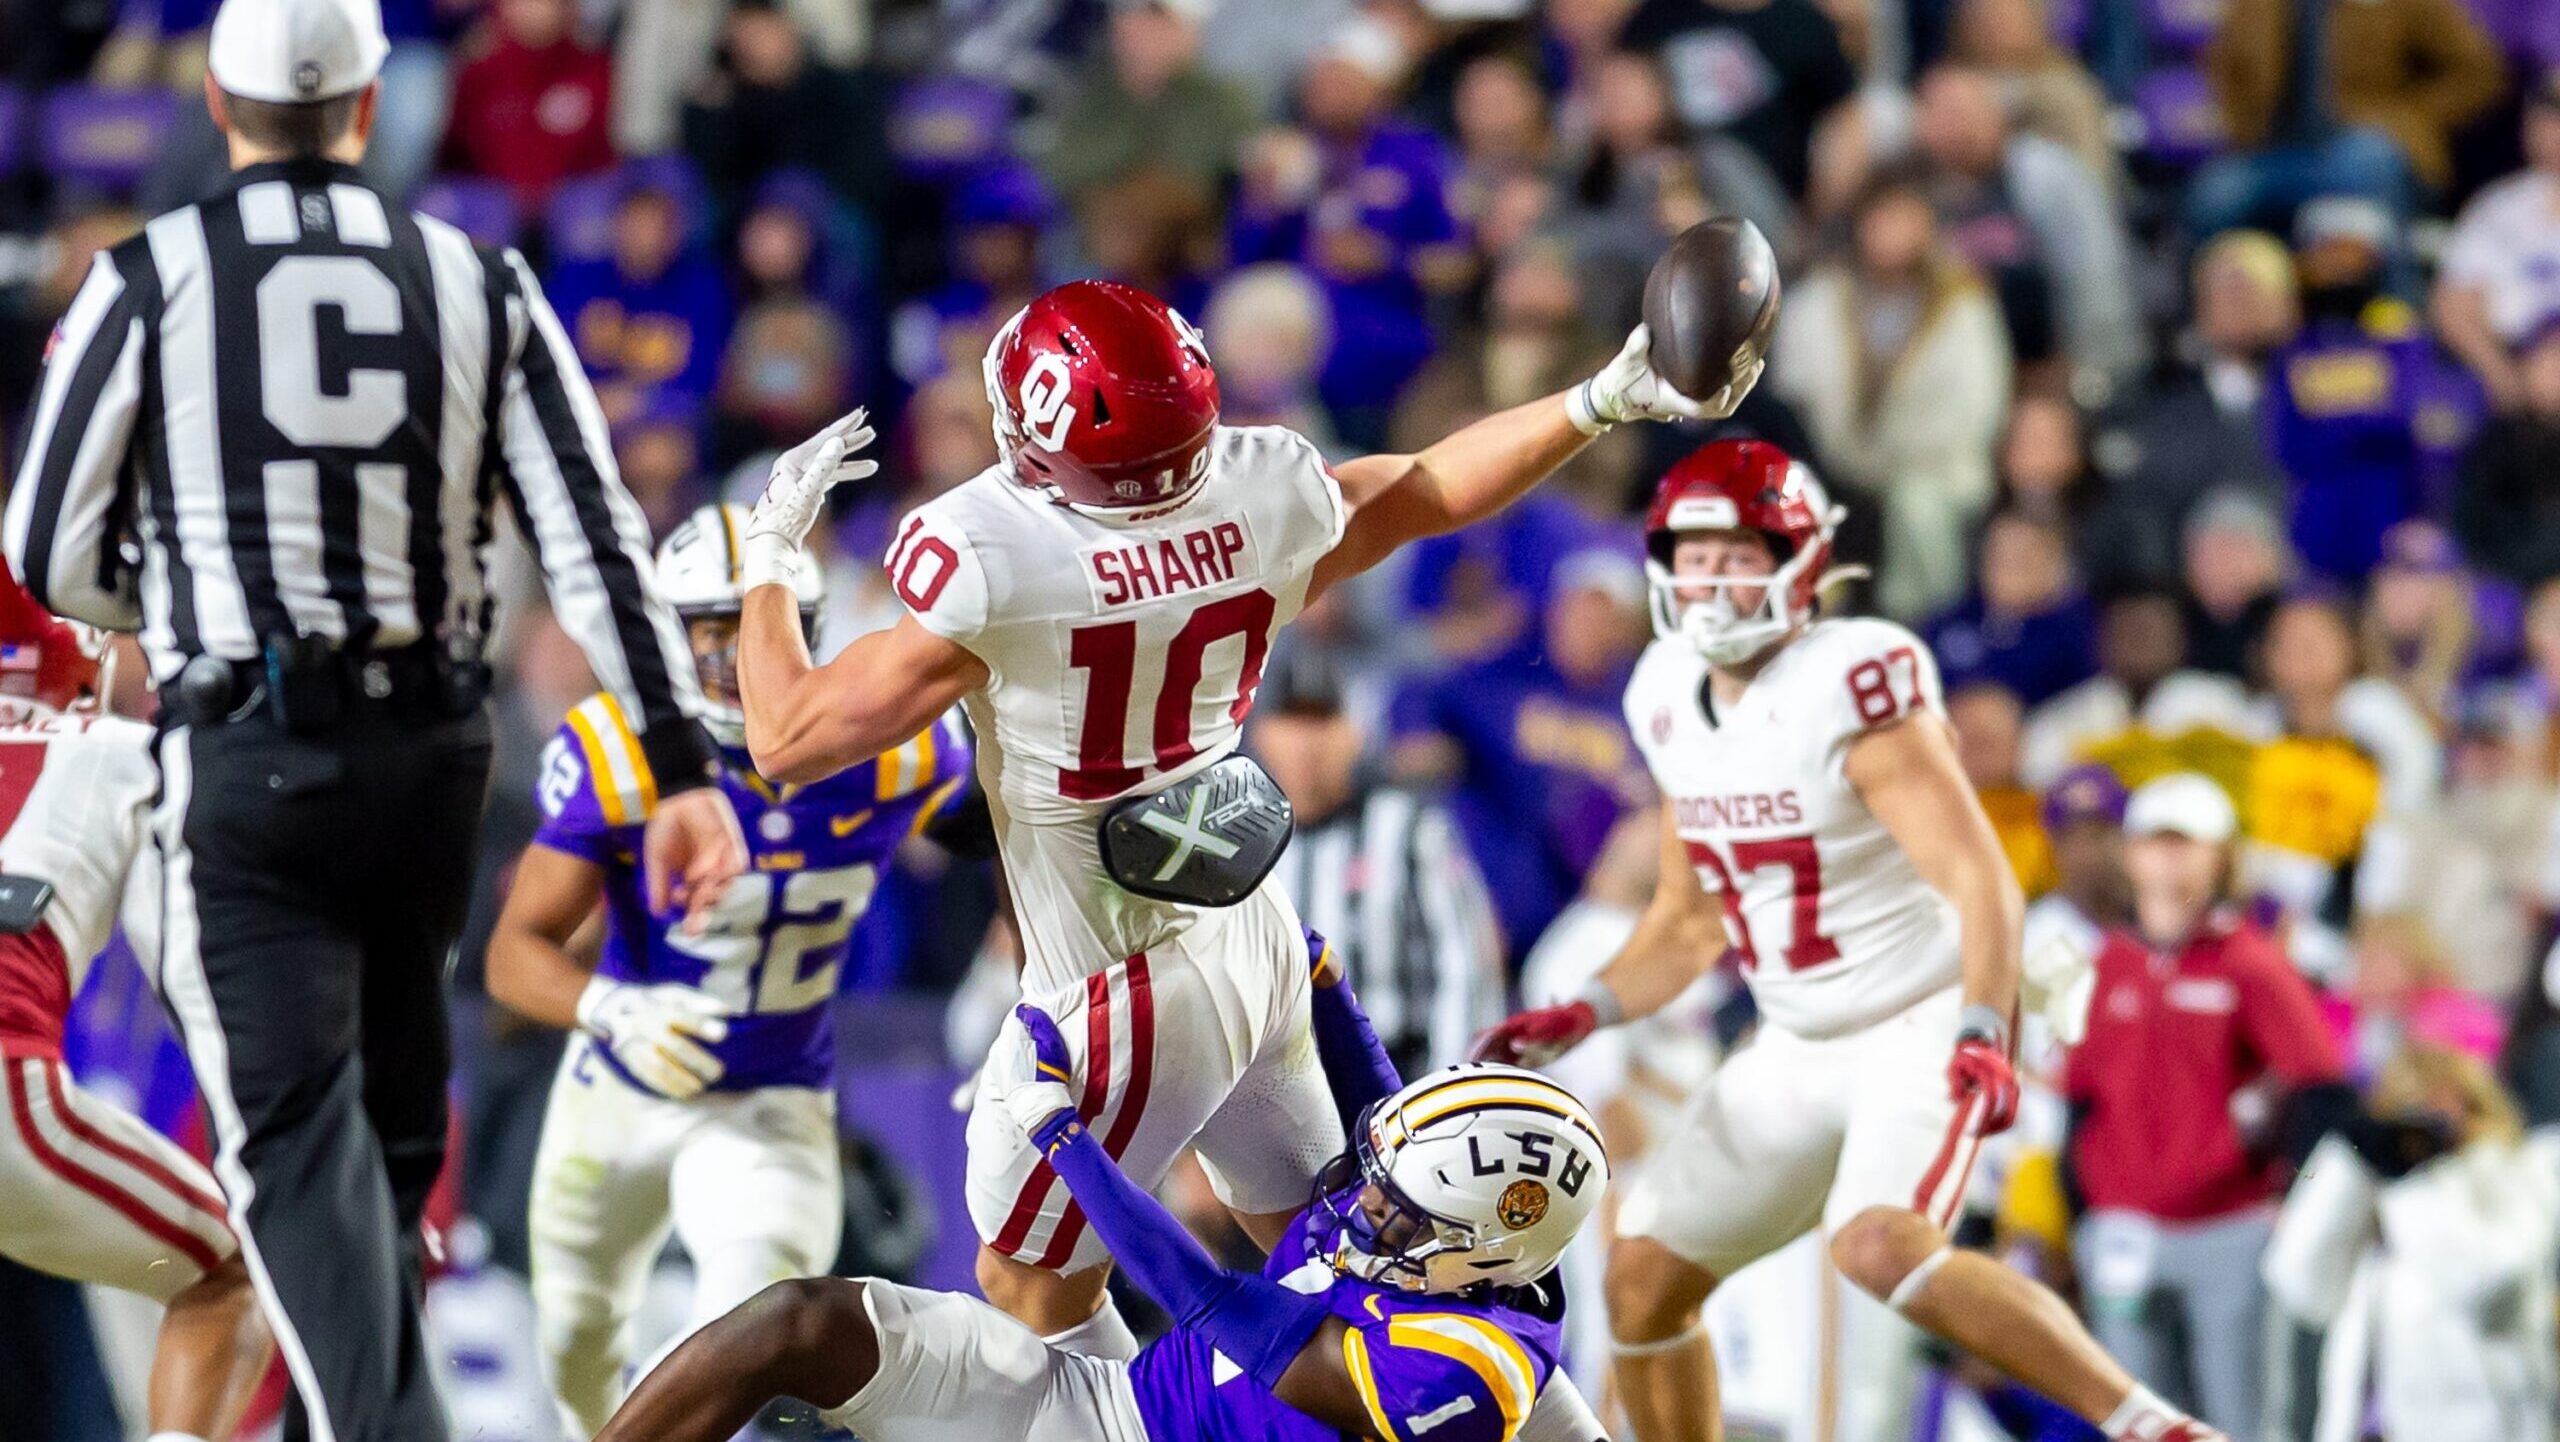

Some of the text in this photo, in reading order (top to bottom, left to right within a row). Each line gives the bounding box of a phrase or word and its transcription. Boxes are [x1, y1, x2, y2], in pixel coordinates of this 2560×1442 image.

[256, 255, 408, 448] C
[1159, 446, 1209, 495] 10
[884, 517, 959, 612] 10
[1092, 521, 1245, 606] SHARP
[1058, 587, 1277, 801] 10
[1846, 646, 1925, 726] 87
[1467, 1131, 1592, 1198] LSU
[1406, 1395, 1476, 1436] 1
